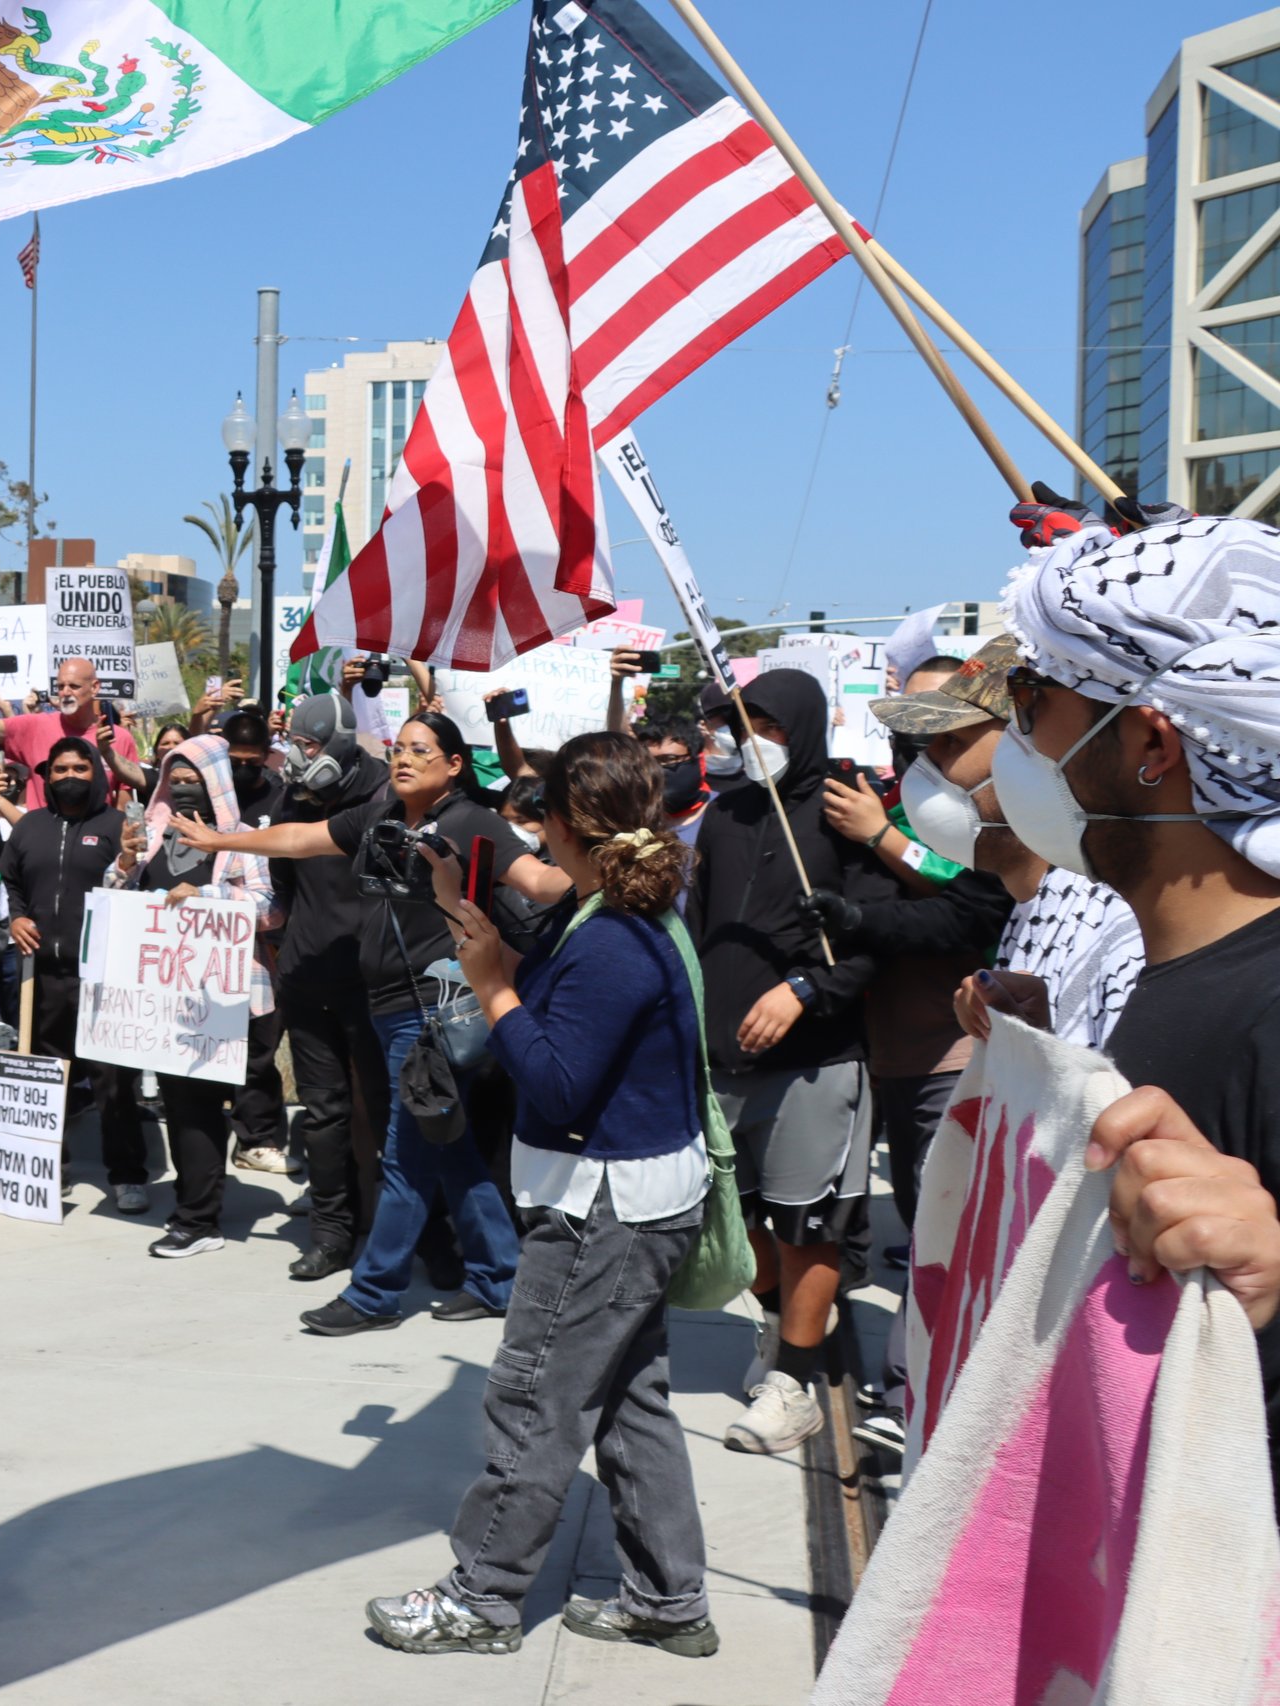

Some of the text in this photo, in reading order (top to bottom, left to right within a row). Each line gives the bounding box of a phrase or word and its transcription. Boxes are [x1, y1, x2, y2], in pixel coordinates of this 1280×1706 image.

[78, 574, 126, 590] PUEBLO
[61, 591, 123, 614] UNIDO
[53, 644, 131, 657] A LAS FAMILIAS
[54, 657, 132, 673] MNTES!
[145, 905, 252, 946] I STAND
[137, 944, 251, 994] FOR ALL
[163, 995, 210, 1027] HARD
[82, 1018, 159, 1052] WORKERS
[24, 1087, 48, 1106] FOR
[31, 1155, 54, 1181] NO
[25, 1184, 48, 1209] NO
